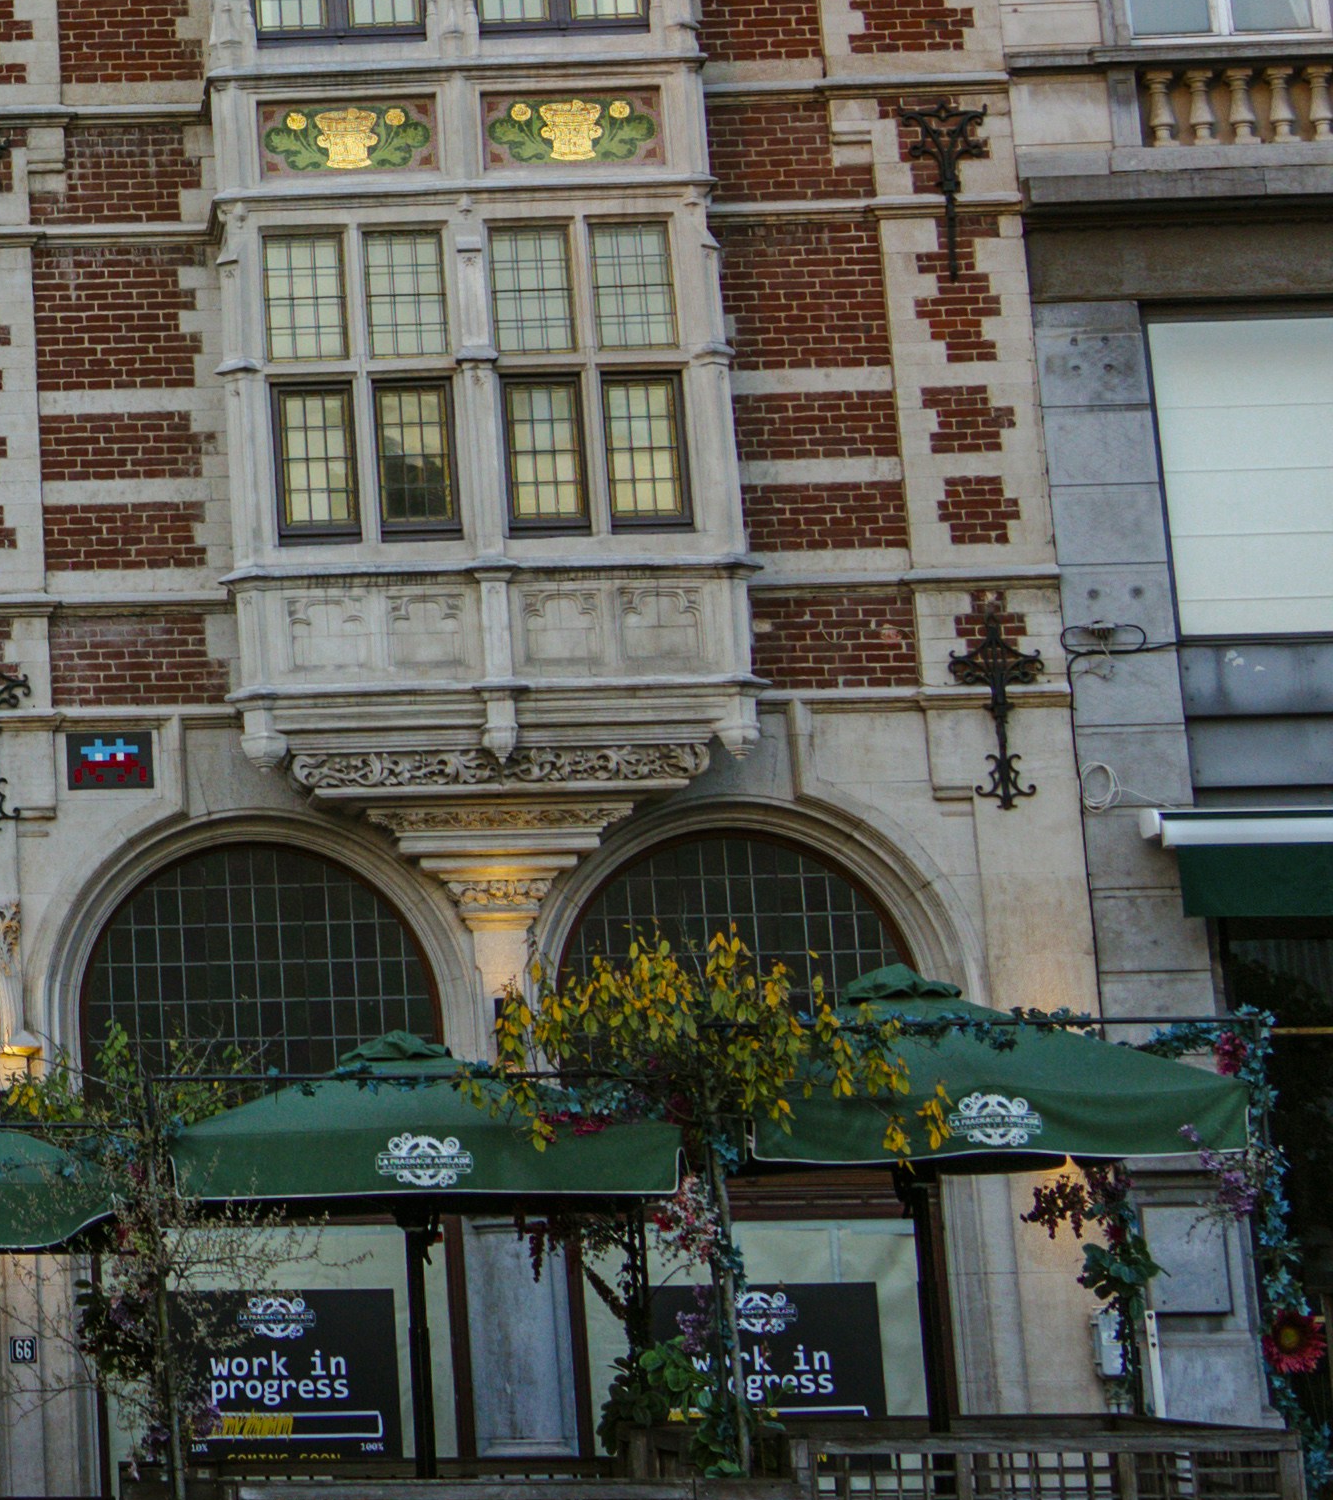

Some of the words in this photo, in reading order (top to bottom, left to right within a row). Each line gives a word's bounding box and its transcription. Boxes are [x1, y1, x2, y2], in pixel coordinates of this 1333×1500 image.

[15, 1339, 32, 1360] 66
[210, 1350, 289, 1377] work
[310, 1349, 347, 1377] in
[792, 1343, 831, 1371] in
[211, 1377, 350, 1406] progress
